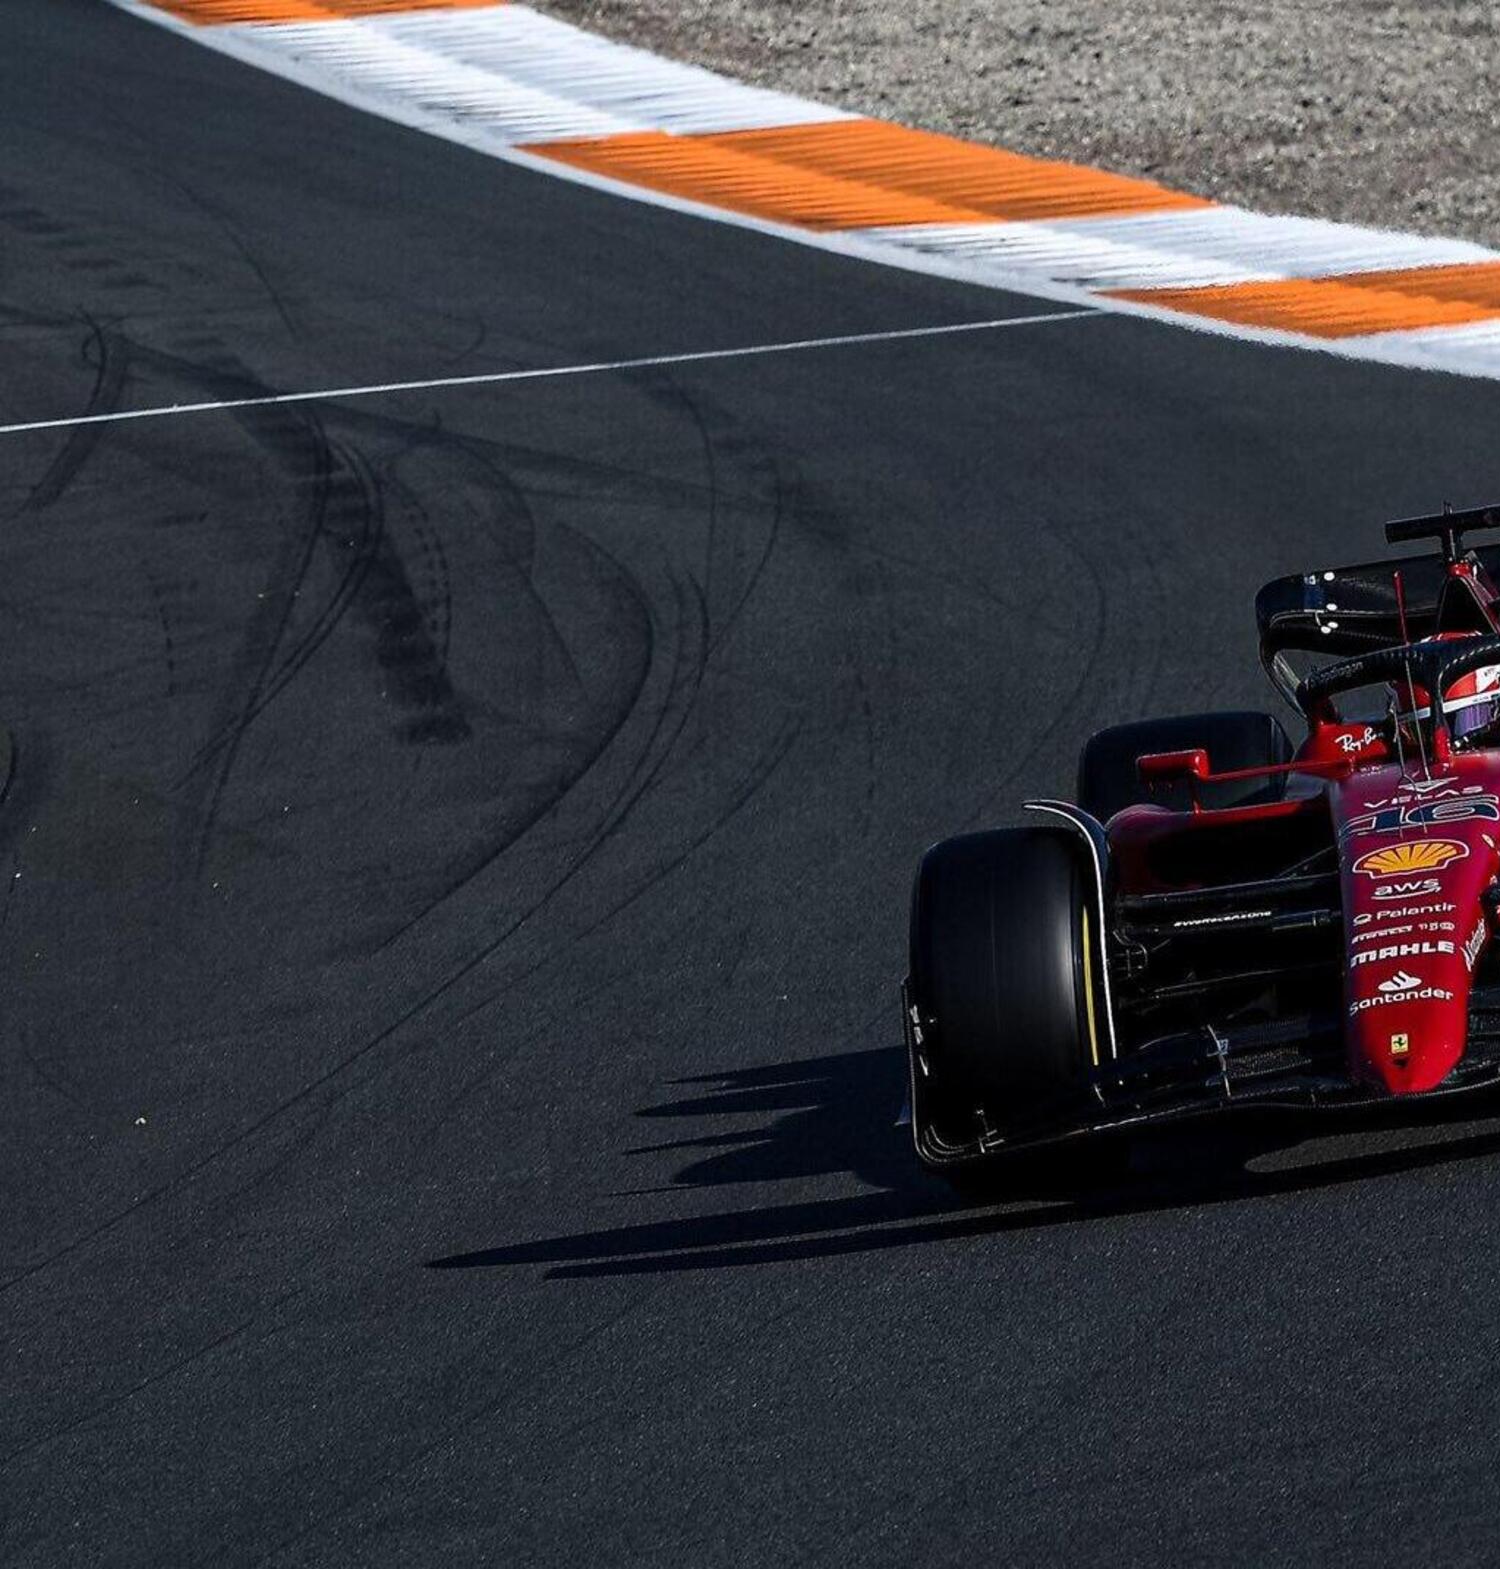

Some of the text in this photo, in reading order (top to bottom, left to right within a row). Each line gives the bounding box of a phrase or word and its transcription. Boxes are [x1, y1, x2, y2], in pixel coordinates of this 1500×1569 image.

[1338, 795, 1499, 841] 16
[1373, 879, 1441, 898] aws
[1376, 902, 1456, 920] Palantir
[1350, 940, 1455, 968] MAHLE
[1350, 987, 1454, 1017] Santander
